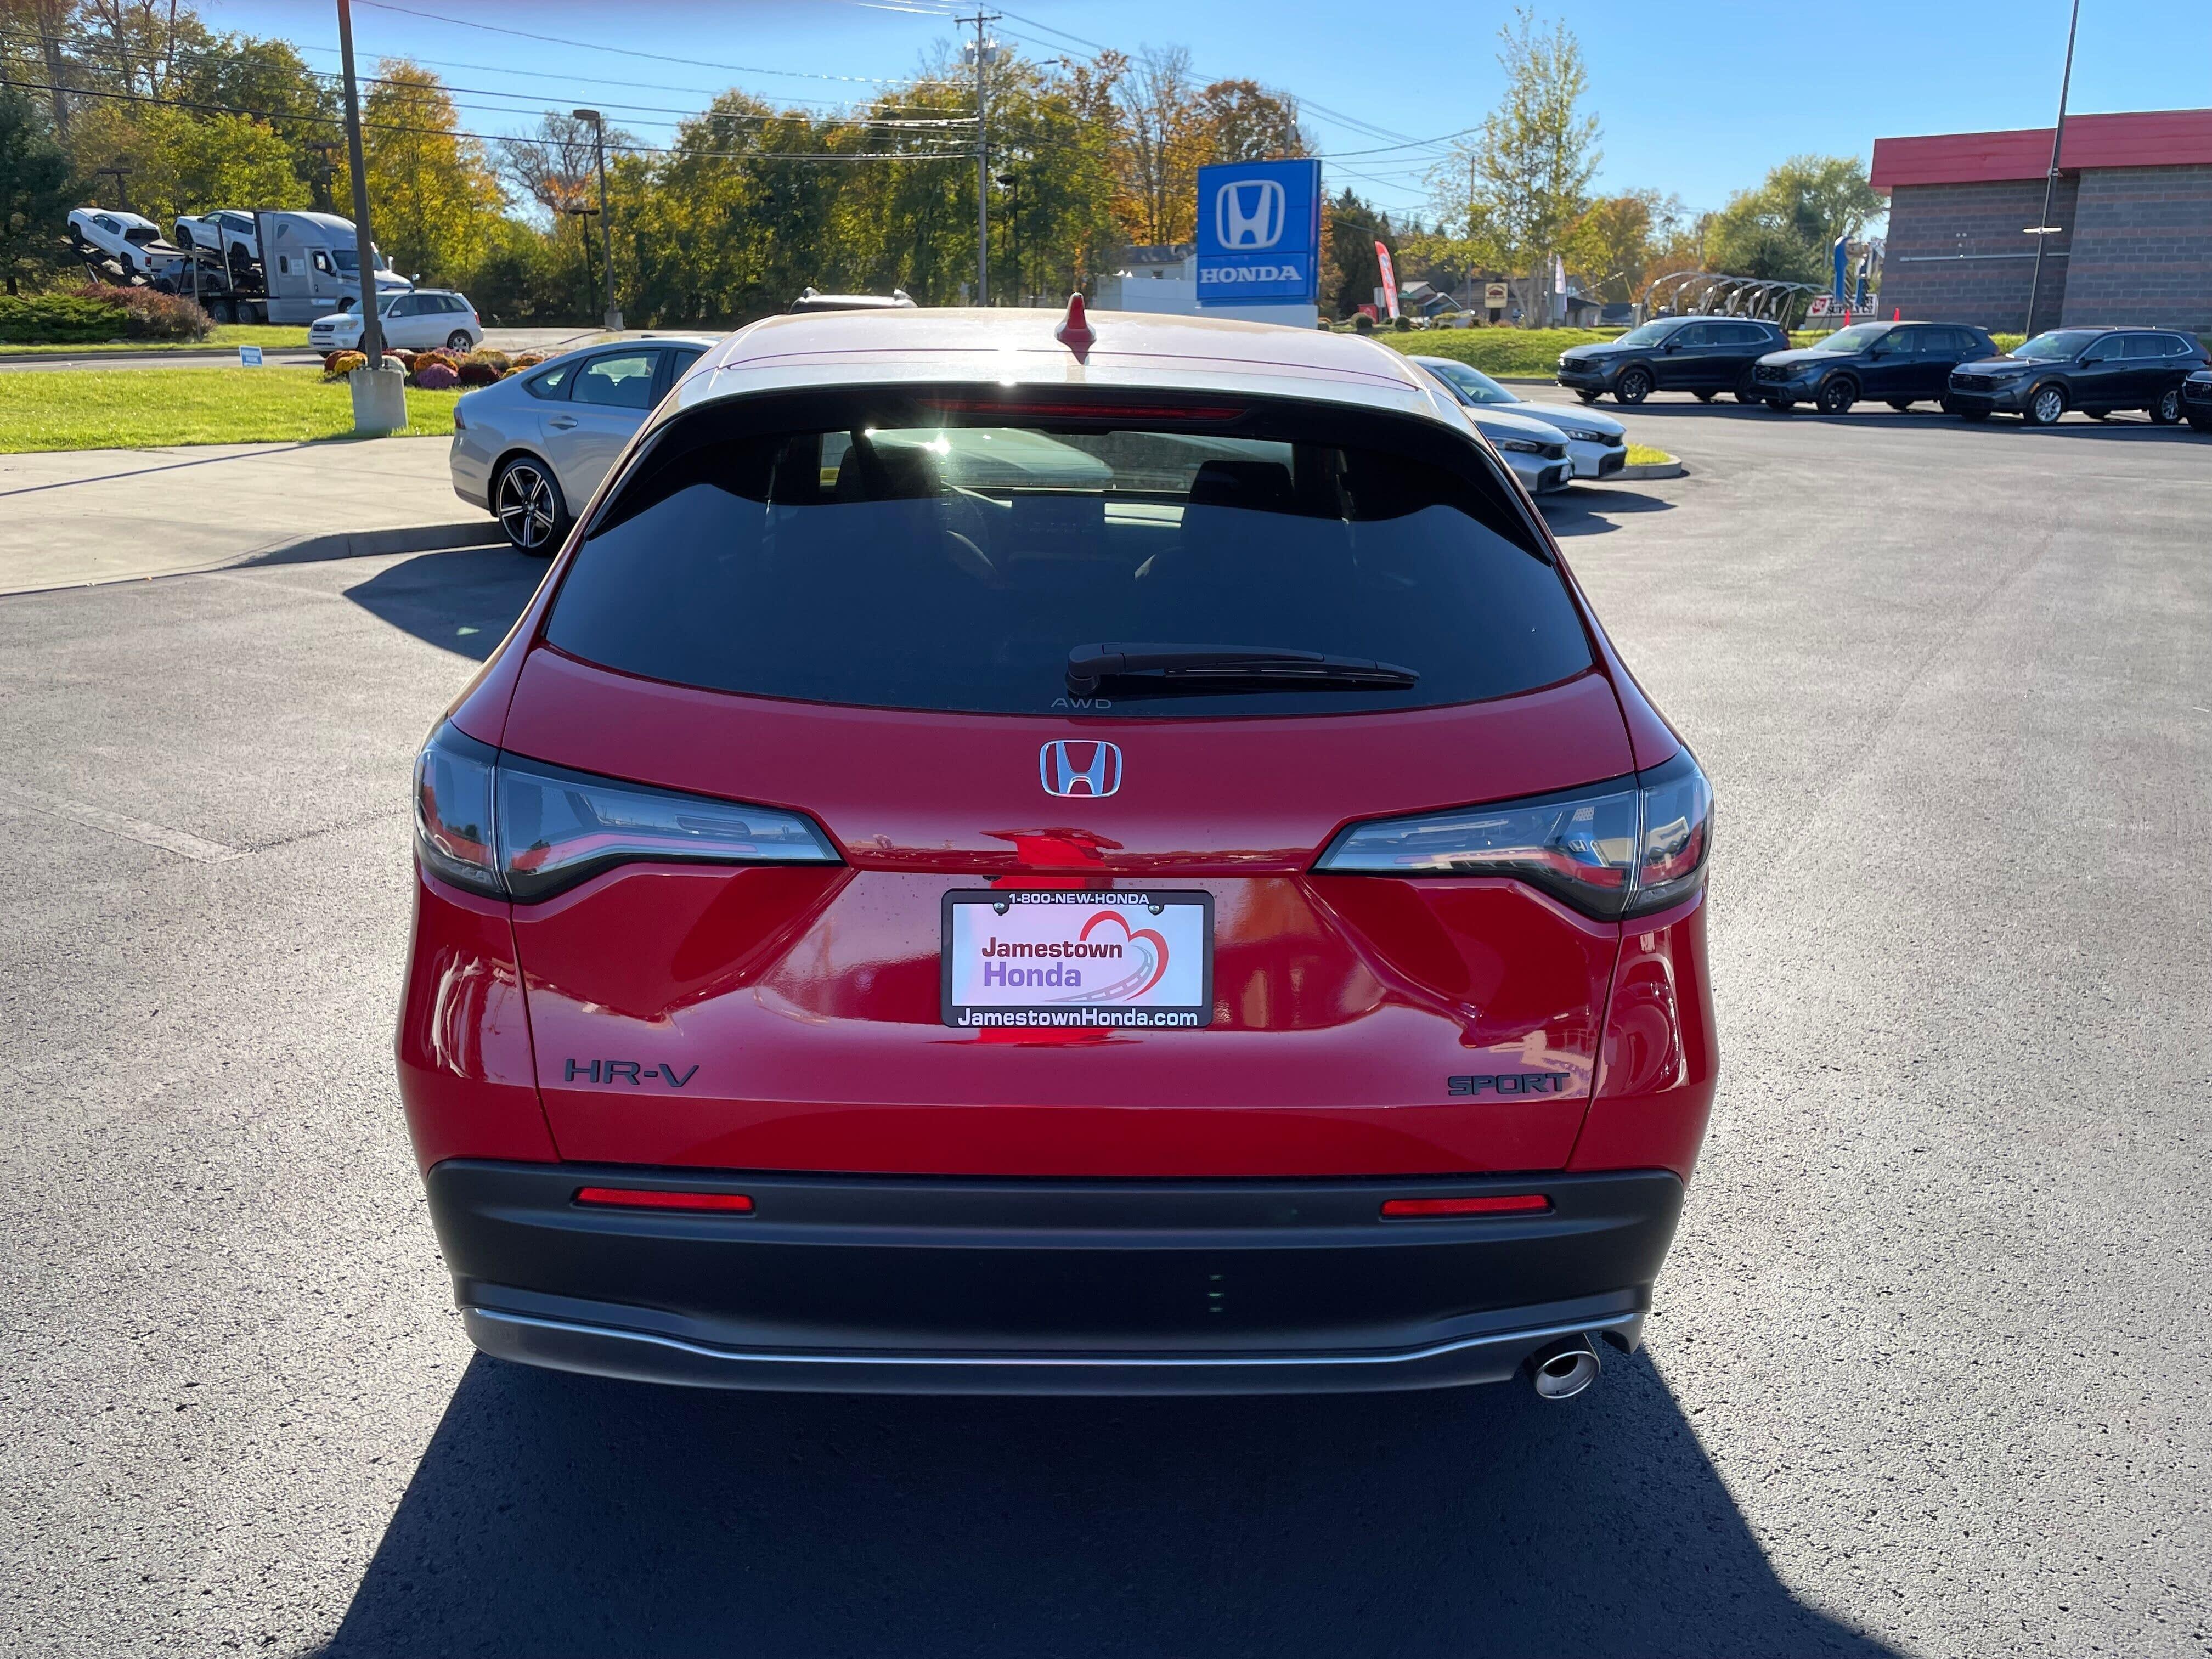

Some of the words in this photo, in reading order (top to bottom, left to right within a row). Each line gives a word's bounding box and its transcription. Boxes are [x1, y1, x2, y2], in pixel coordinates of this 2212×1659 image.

[1199, 266, 1303, 284] HONDA
[1051, 698, 1111, 709] AWD
[1008, 893, 1150, 905] 1-800-NEW-HONDA
[981, 936, 1123, 958] Jamestown
[984, 961, 1082, 987] Honda
[957, 1007, 1198, 1027] JamestownHonda.com
[565, 1058, 700, 1088] HR-V
[1447, 1072, 1571, 1096] SPORT
